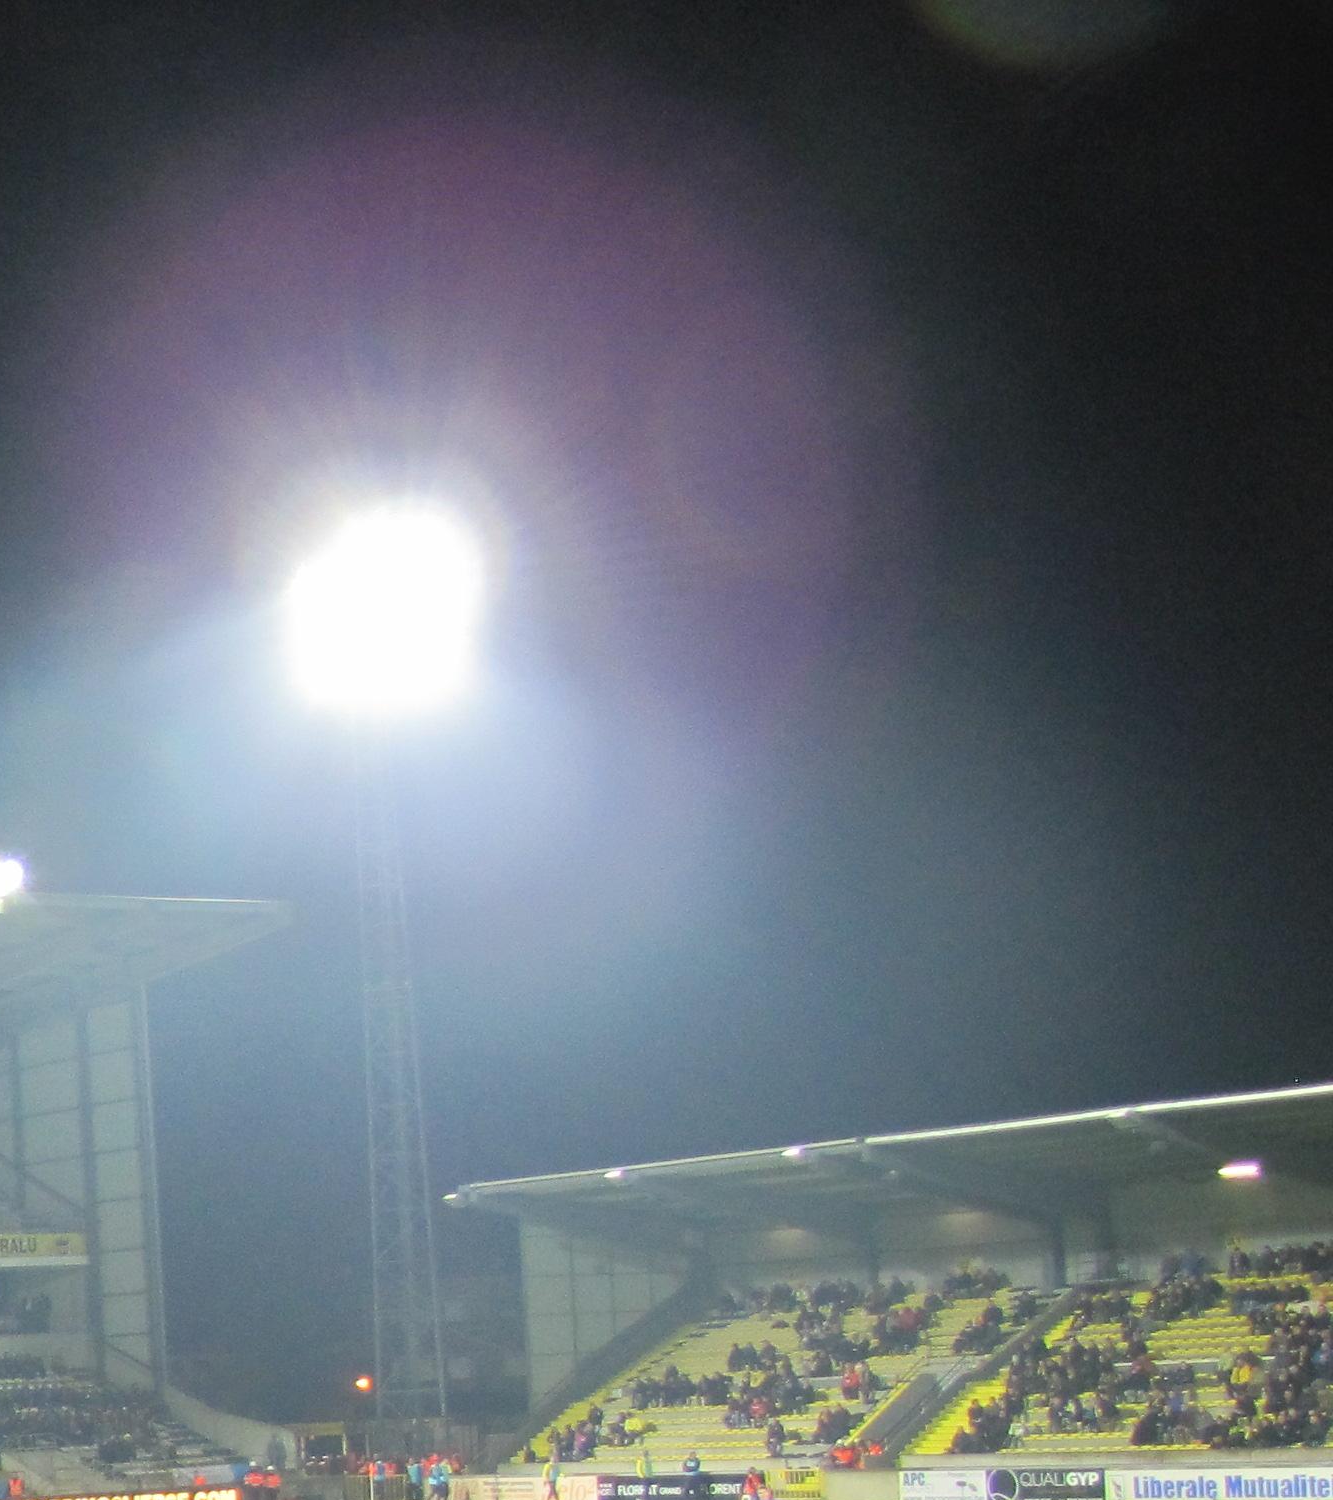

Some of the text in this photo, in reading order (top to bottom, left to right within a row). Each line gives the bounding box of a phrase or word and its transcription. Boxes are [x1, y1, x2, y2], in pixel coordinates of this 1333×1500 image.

[903, 1472, 926, 1487] APC
[1020, 1472, 1100, 1487] QUALIGYP
[1133, 1475, 1218, 1500] Liberale
